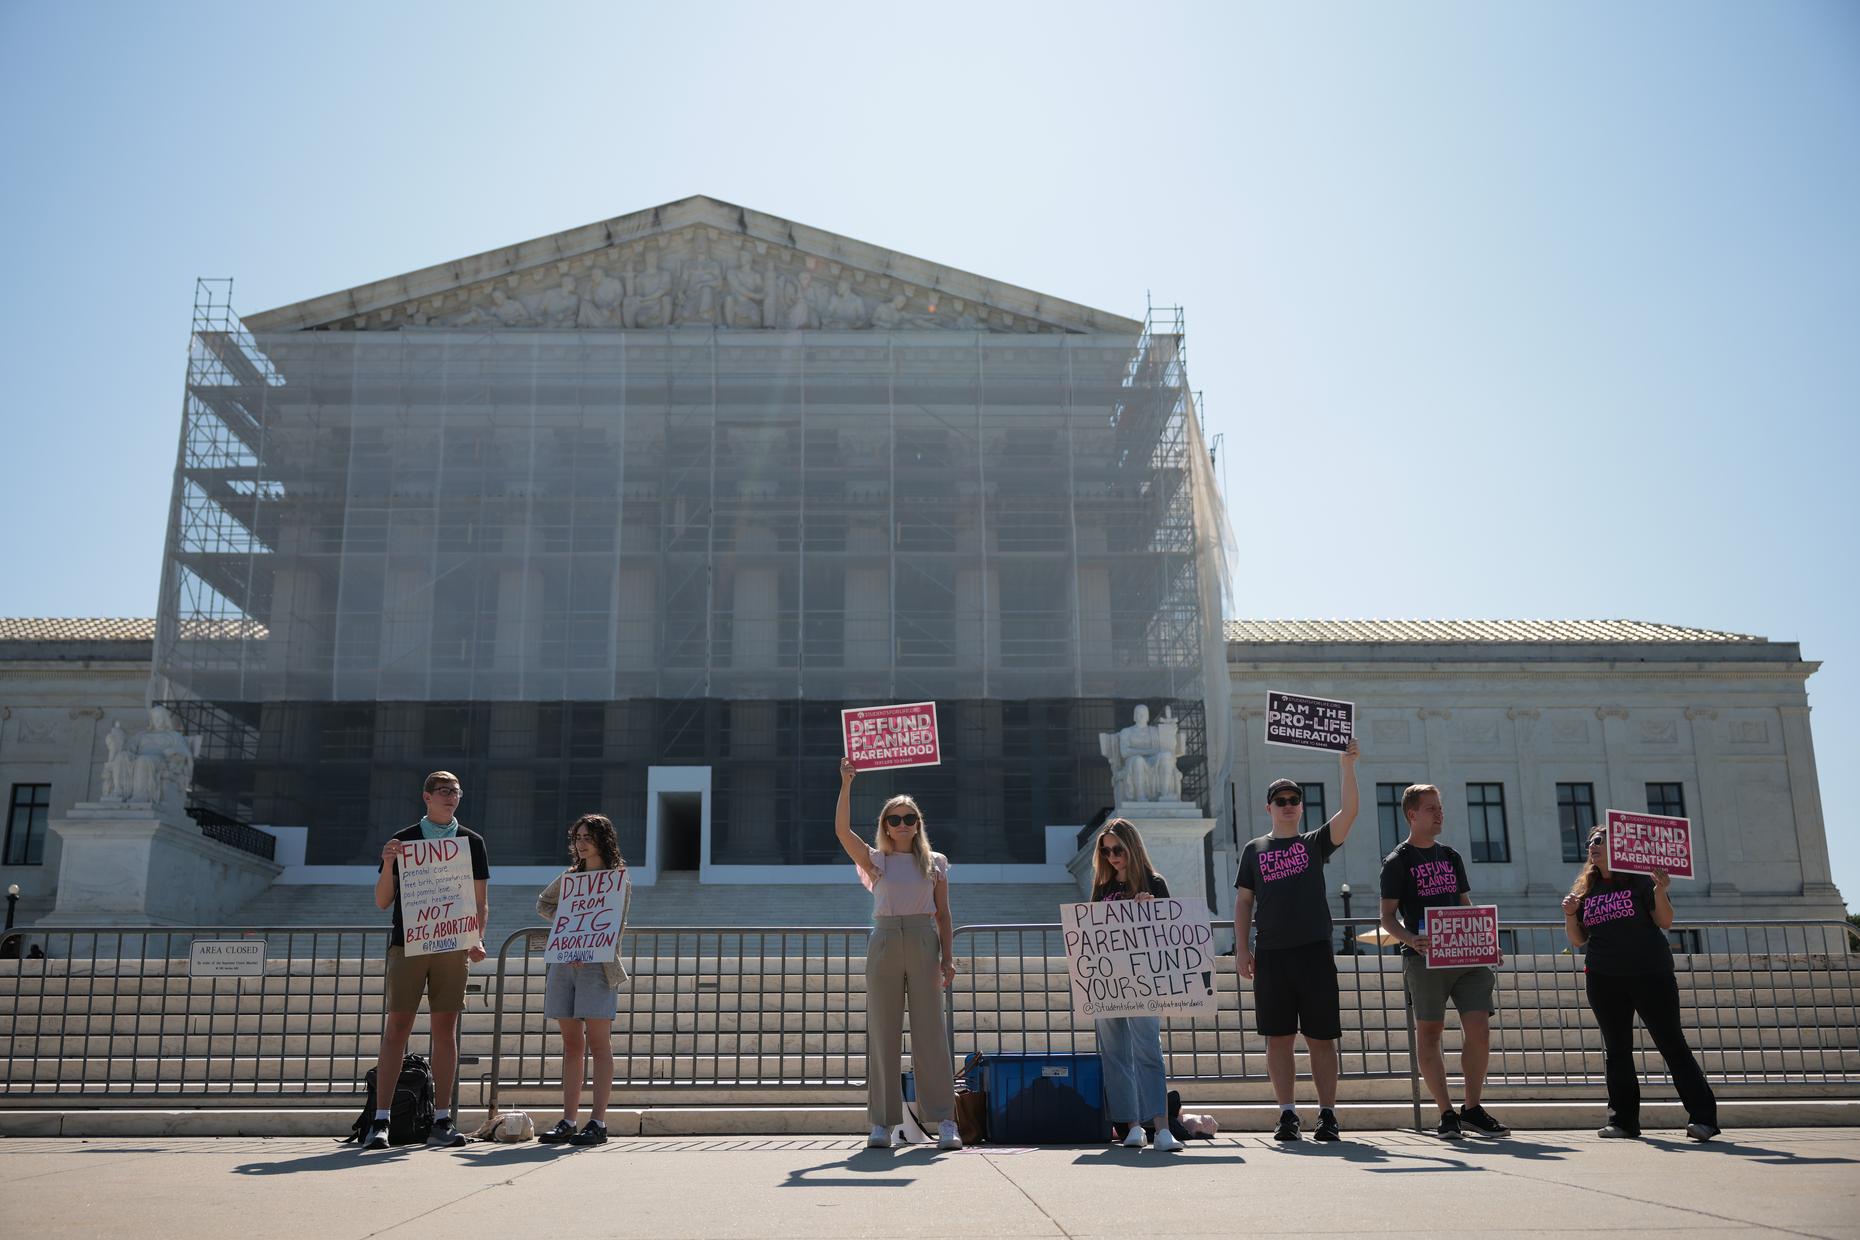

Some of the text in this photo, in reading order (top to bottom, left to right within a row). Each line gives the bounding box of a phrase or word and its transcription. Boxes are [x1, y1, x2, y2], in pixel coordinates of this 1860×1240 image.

[1273, 701, 1347, 719] I AM THE
[849, 713, 931, 736] DEFUND
[1269, 710, 1351, 734] PRO-LIFE
[851, 730, 933, 750] PLANNED
[1270, 725, 1349, 745] GENERATION
[852, 744, 934, 761] PARENTHOOD
[1613, 821, 1686, 844] DEFUND
[401, 840, 459, 868] FUND
[1258, 842, 1305, 864] DEFUND
[1613, 837, 1688, 857] PLANNED
[1260, 853, 1309, 875] PLANNED
[1614, 851, 1688, 868] PARENTHOOD
[563, 870, 626, 900] DIVEST
[570, 896, 606, 913] FROM
[1584, 890, 1632, 910] DEFUND
[1584, 899, 1633, 920] PLANNED
[417, 902, 454, 922] NOT
[554, 908, 614, 934] BIG
[1075, 900, 1182, 928] PLANNED
[406, 913, 478, 943] BIG ABORTION
[1431, 916, 1493, 933] DEFUND
[548, 932, 616, 951] ABORTION
[1065, 924, 1210, 956] PARENTHOOD
[1432, 932, 1494, 947] PLANNED
[200, 946, 258, 954] AREA CLOSED
[1432, 946, 1495, 958] PARENTHOOD
[1077, 946, 1202, 978] GO FUND
[1075, 971, 1213, 1002] YOURSELF!
